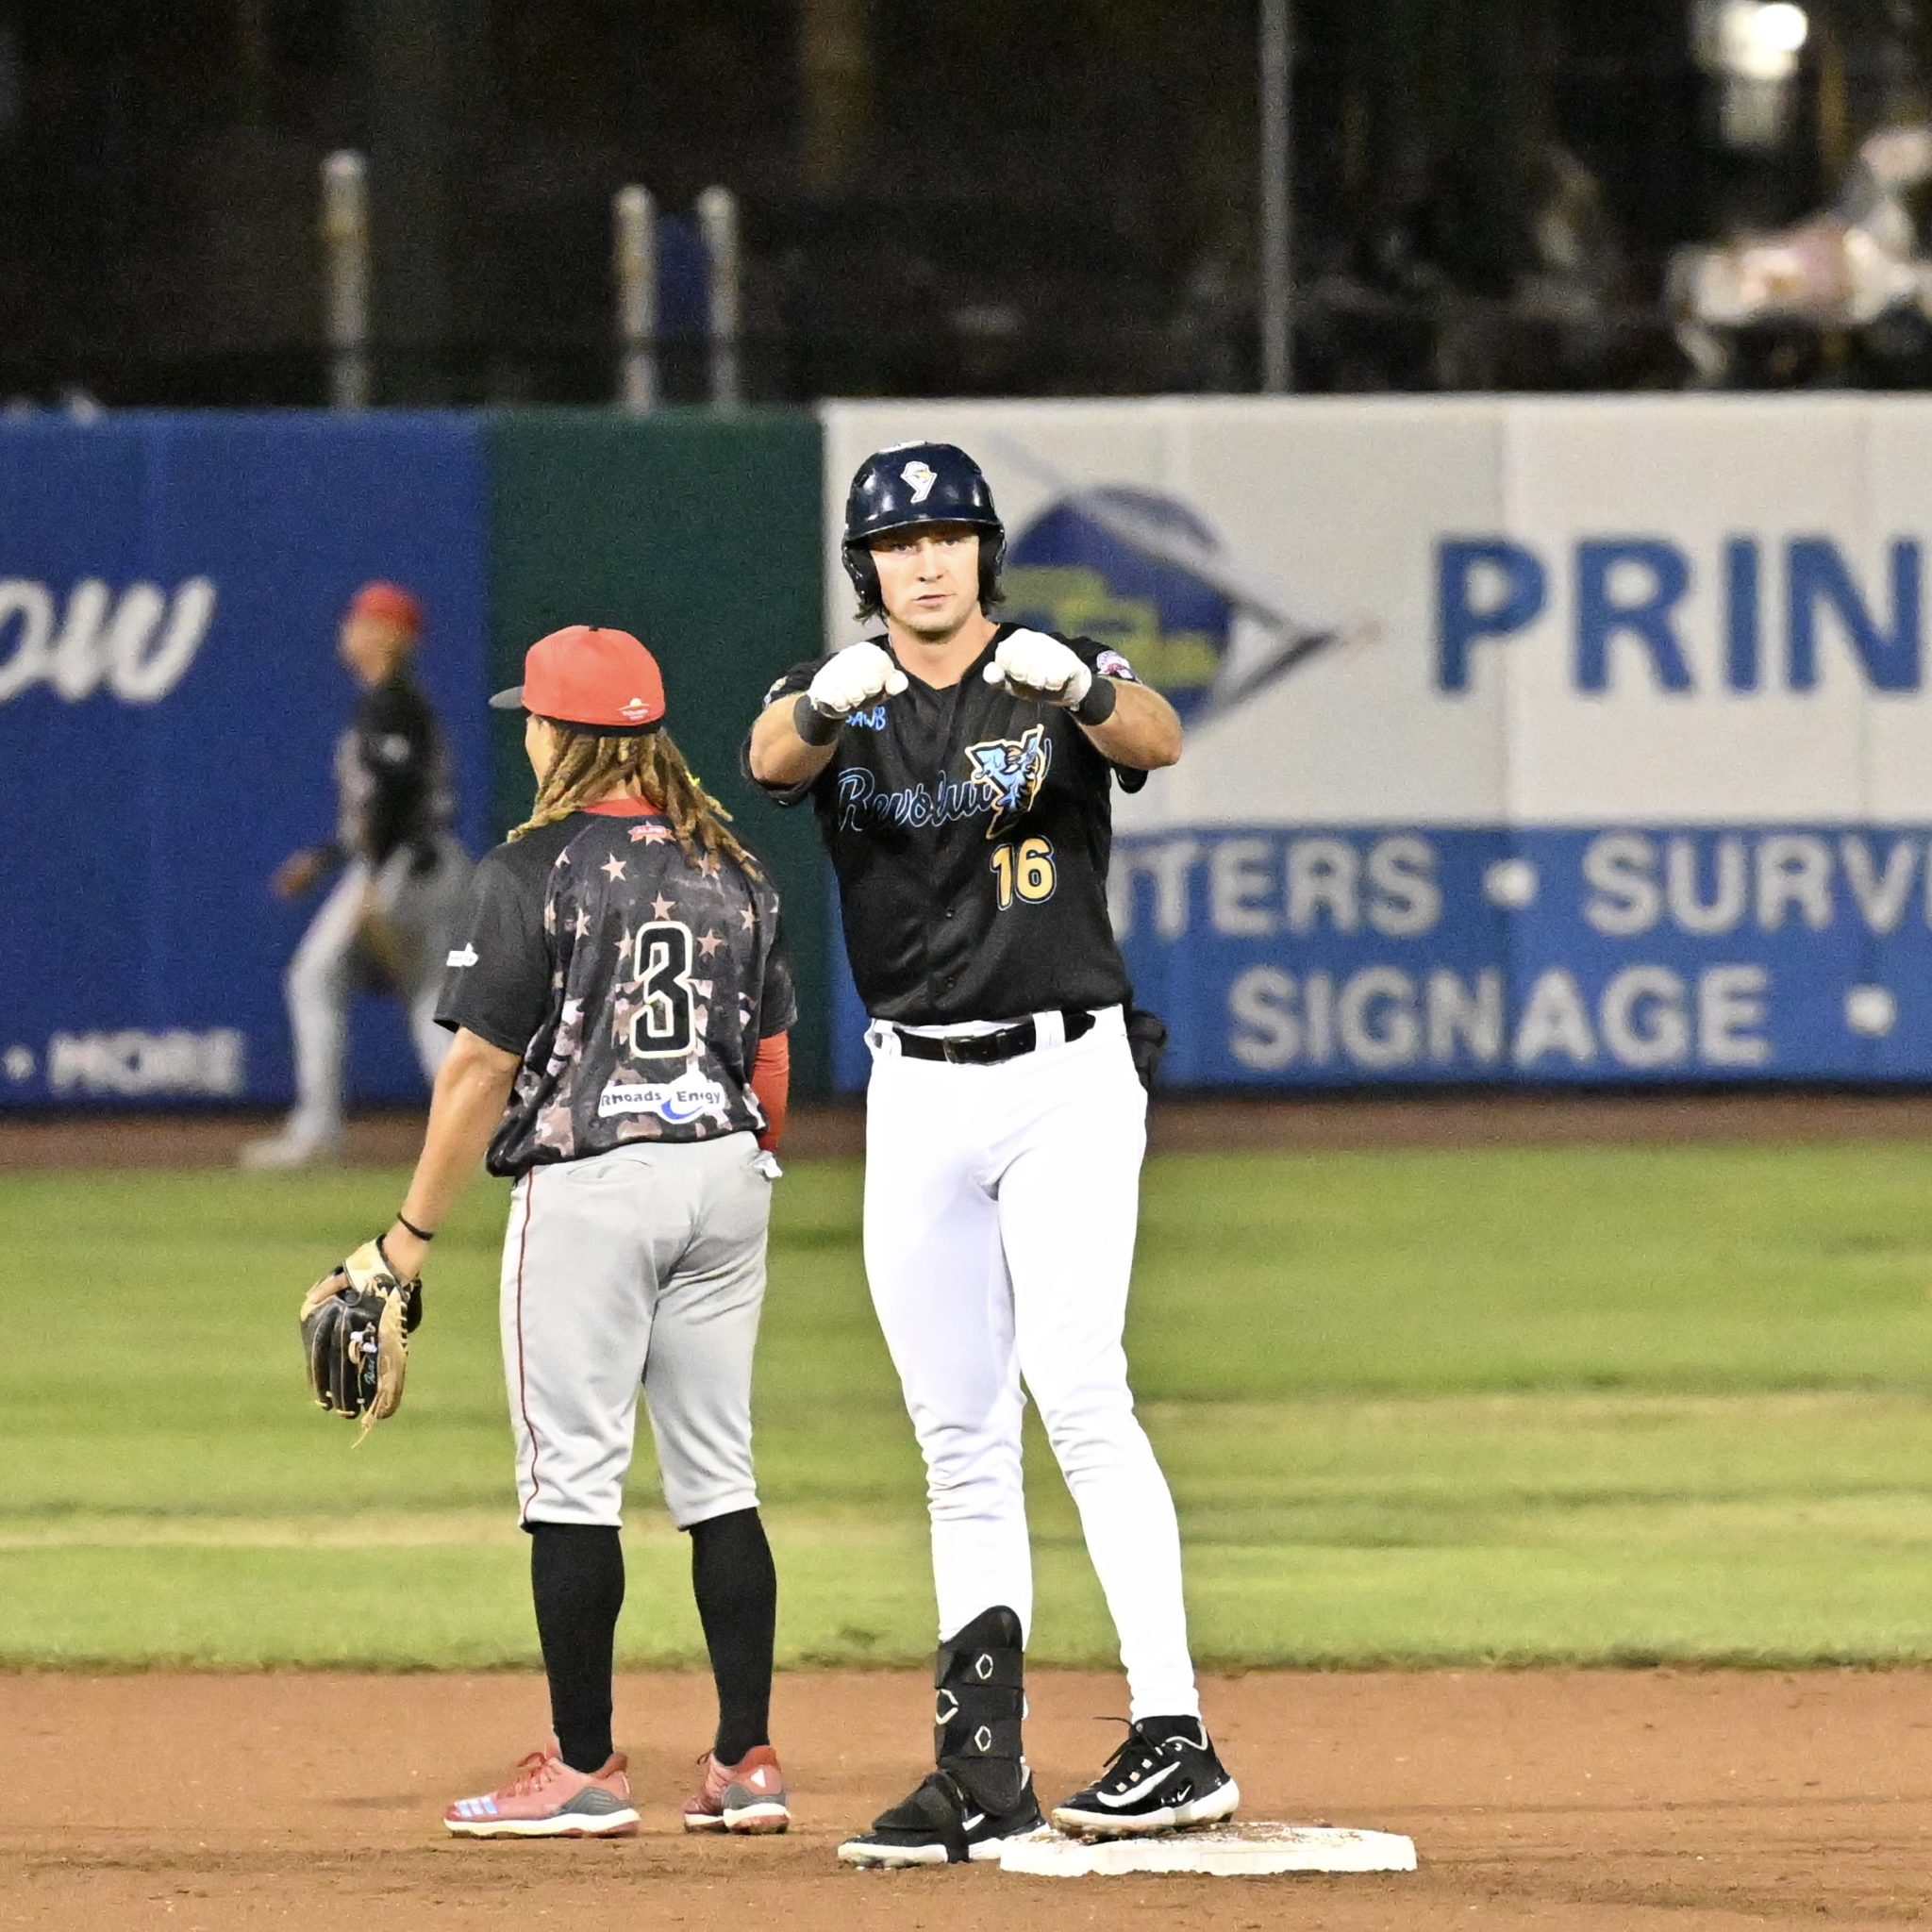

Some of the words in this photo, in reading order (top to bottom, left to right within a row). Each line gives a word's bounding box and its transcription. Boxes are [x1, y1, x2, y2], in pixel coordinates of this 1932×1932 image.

[1435, 535, 1921, 694] PRIN
[990, 836, 1057, 910] 16
[1582, 833, 1932, 938] SURV
[629, 920, 696, 1058] 3
[1228, 962, 1773, 1069] SIGNAGE
[601, 1091, 661, 1107] Rhoads
